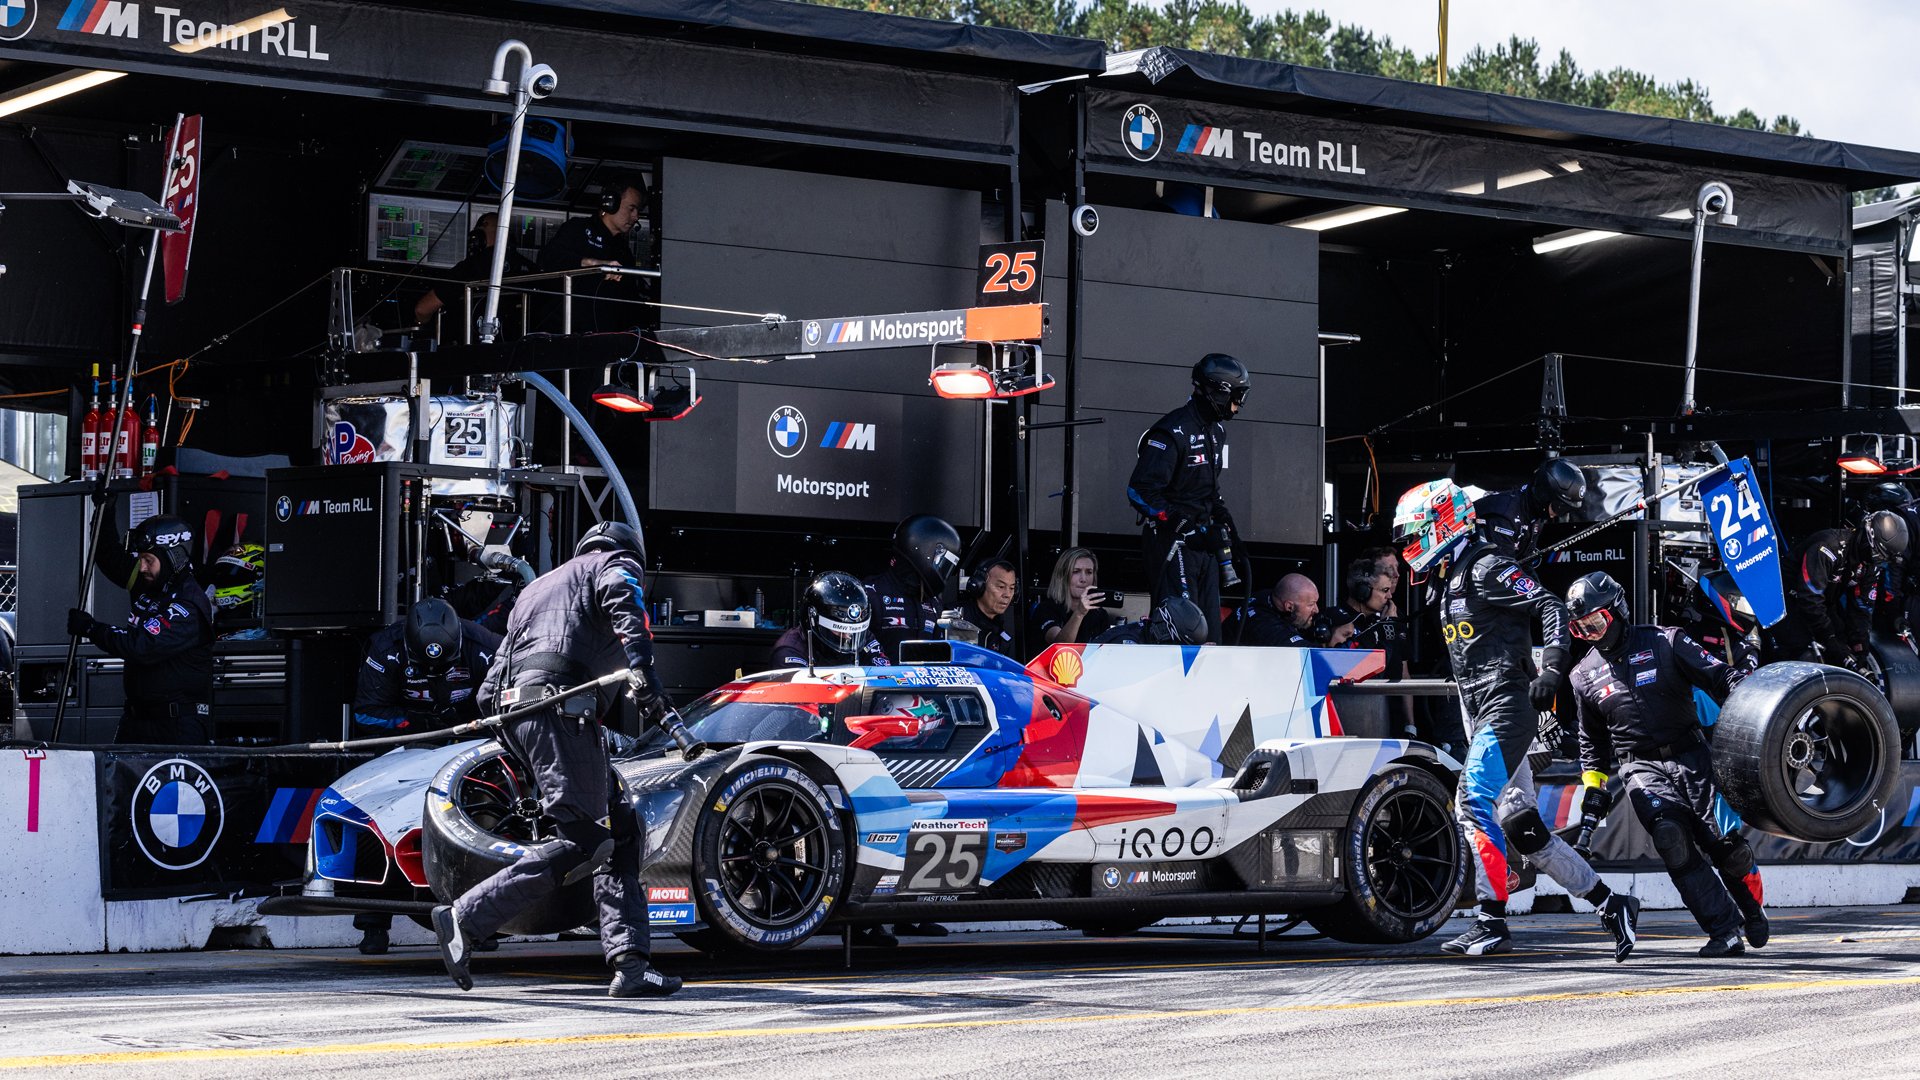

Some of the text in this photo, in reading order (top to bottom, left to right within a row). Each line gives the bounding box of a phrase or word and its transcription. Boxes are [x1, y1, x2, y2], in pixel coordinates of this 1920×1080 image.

[154, 6, 250, 52] Team
[261, 19, 330, 61] RLL
[1243, 131, 1311, 168] Team
[1318, 140, 1366, 175] RLL
[982, 251, 1037, 294] 25
[870, 316, 964, 342] Motorsport
[772, 408, 803, 424] BMW
[450, 418, 482, 444] 25
[777, 474, 870, 500] Motorsport
[323, 500, 350, 514] Team
[353, 497, 373, 512] RLL
[1711, 479, 1761, 541] 24
[1574, 550, 1602, 562] Team
[1605, 549, 1626, 560] RLL
[1735, 546, 1773, 573] Motorsport
[145, 764, 211, 795] BMW
[440, 751, 475, 793] MICHELIN
[731, 766, 784, 795] MICHELIN
[911, 820, 987, 829] WeatherTech
[1118, 826, 1214, 859] iQOO
[1354, 825, 1365, 881] MICHELIN
[908, 833, 981, 889] 25
[1152, 869, 1197, 883] Motorsport
[650, 889, 687, 900] MOTUL
[648, 910, 688, 919] CHELIN
[765, 912, 818, 943] MICHELIN
